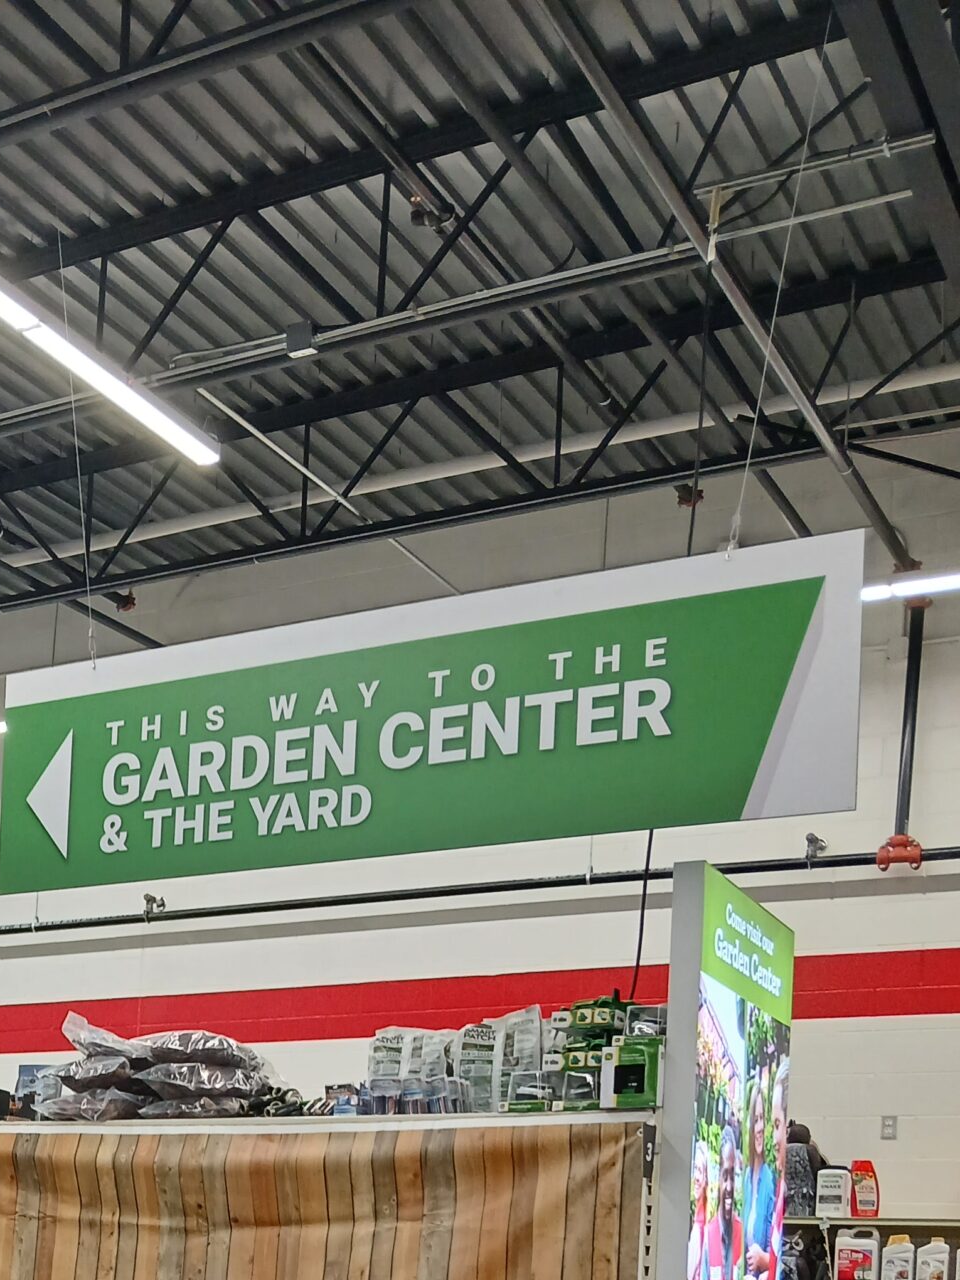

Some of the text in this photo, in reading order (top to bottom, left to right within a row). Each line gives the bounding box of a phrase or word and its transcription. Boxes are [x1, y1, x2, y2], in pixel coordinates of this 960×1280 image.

[106, 637, 668, 746] THIS WAY TO THE
[101, 678, 673, 806] GARDEN CENTER
[98, 784, 373, 854] & THE YARD
[714, 928, 782, 997] Garden Center
[726, 903, 774, 956] Come visit our
